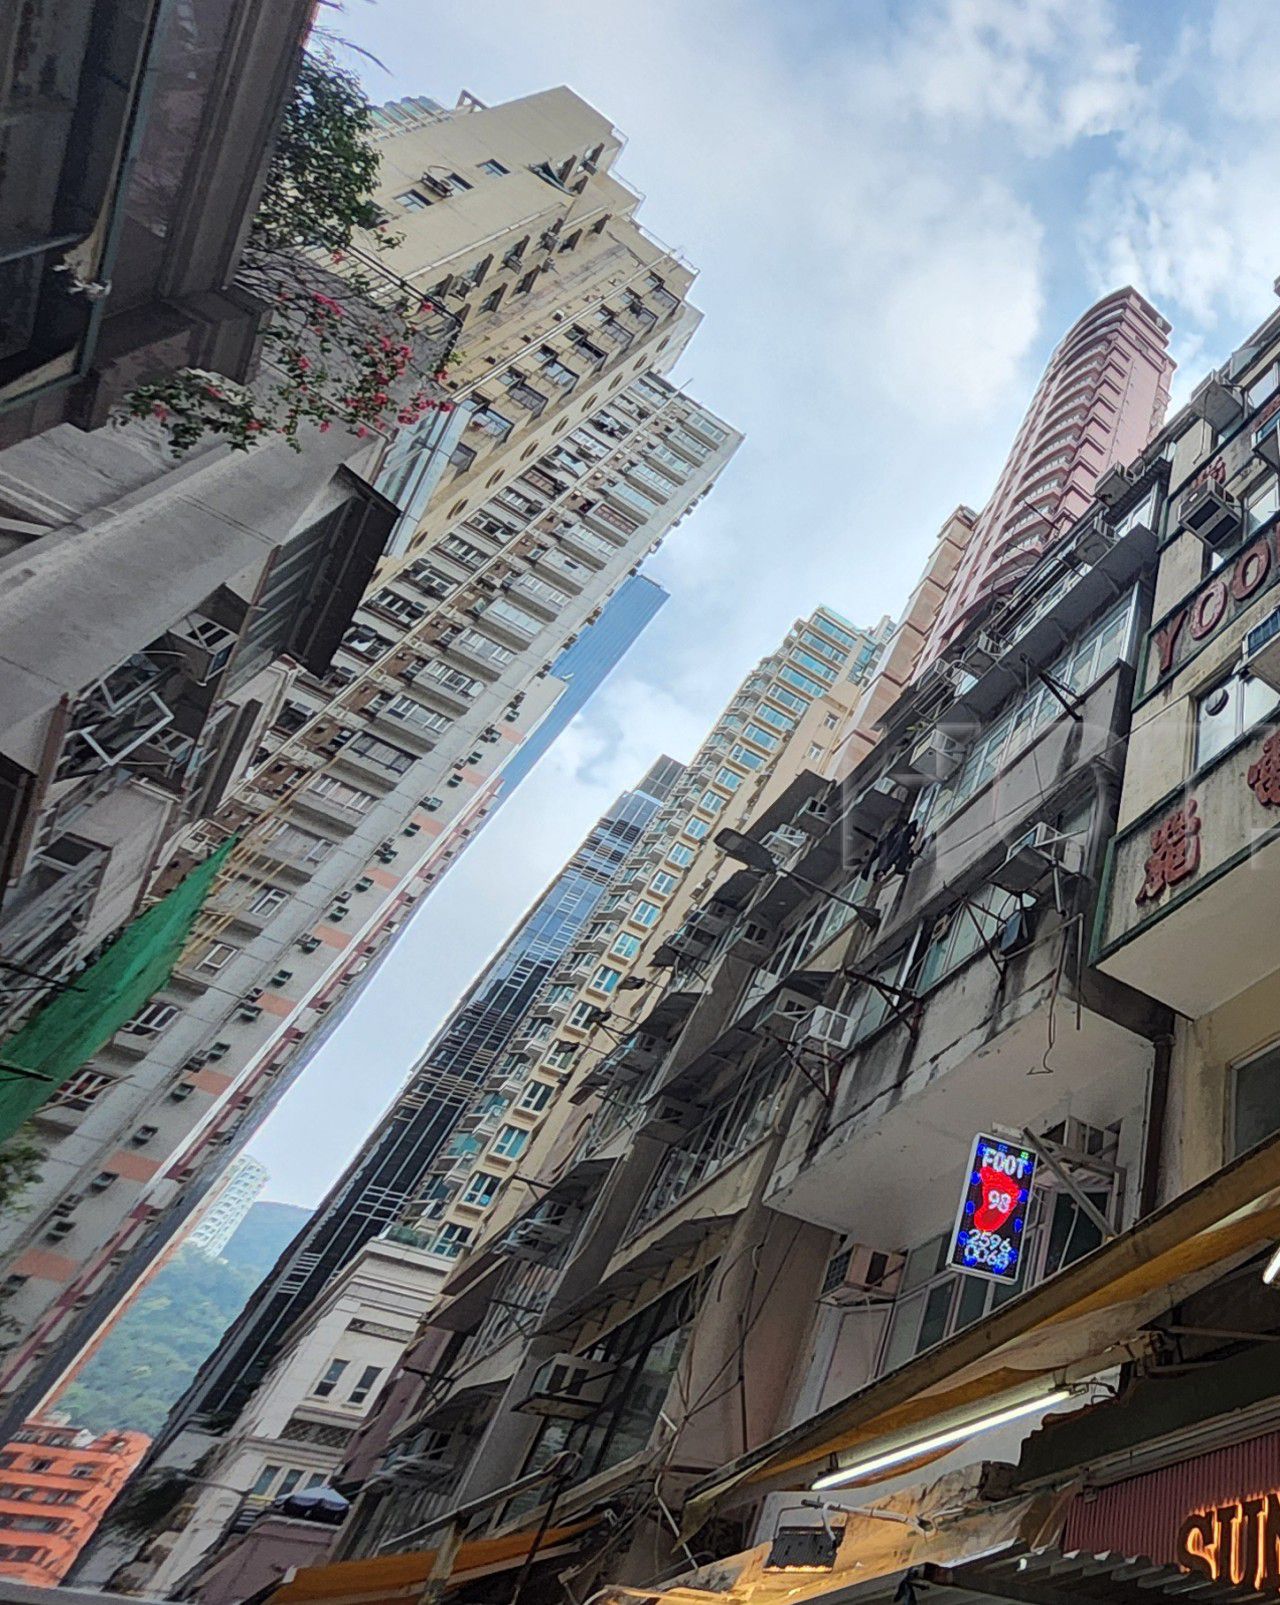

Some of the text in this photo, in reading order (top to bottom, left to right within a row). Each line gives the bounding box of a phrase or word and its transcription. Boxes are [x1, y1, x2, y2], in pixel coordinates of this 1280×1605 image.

[981, 1147, 1029, 1179] FOOT
[988, 1190, 1012, 1213] 98
[968, 1229, 1012, 1251] 2596
